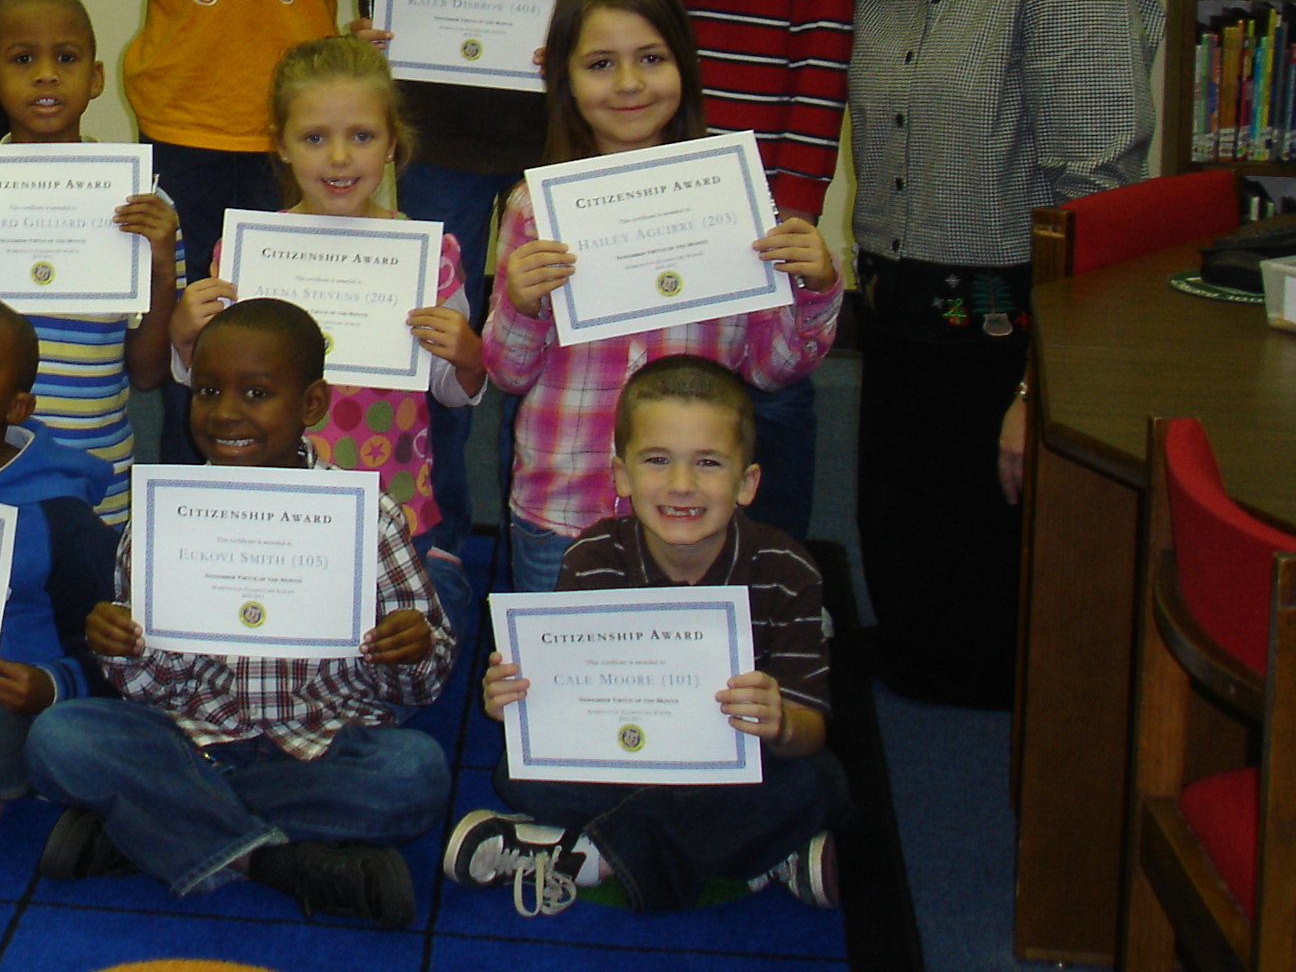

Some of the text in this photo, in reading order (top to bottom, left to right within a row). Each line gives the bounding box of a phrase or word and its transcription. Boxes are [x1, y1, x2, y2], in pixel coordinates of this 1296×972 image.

[65, 179, 112, 190] AWARD
[575, 175, 722, 209] CITIZENSHIP AWARD
[261, 247, 399, 266] CITIZENSHIP AWARD
[177, 505, 333, 525] CITIZENSHIP AWARD
[240, 551, 286, 566] SMITH
[291, 553, 329, 570] (105)
[541, 629, 704, 644] CITIZENSHIP AWARD
[553, 673, 701, 688] CALE MOORE (101)
